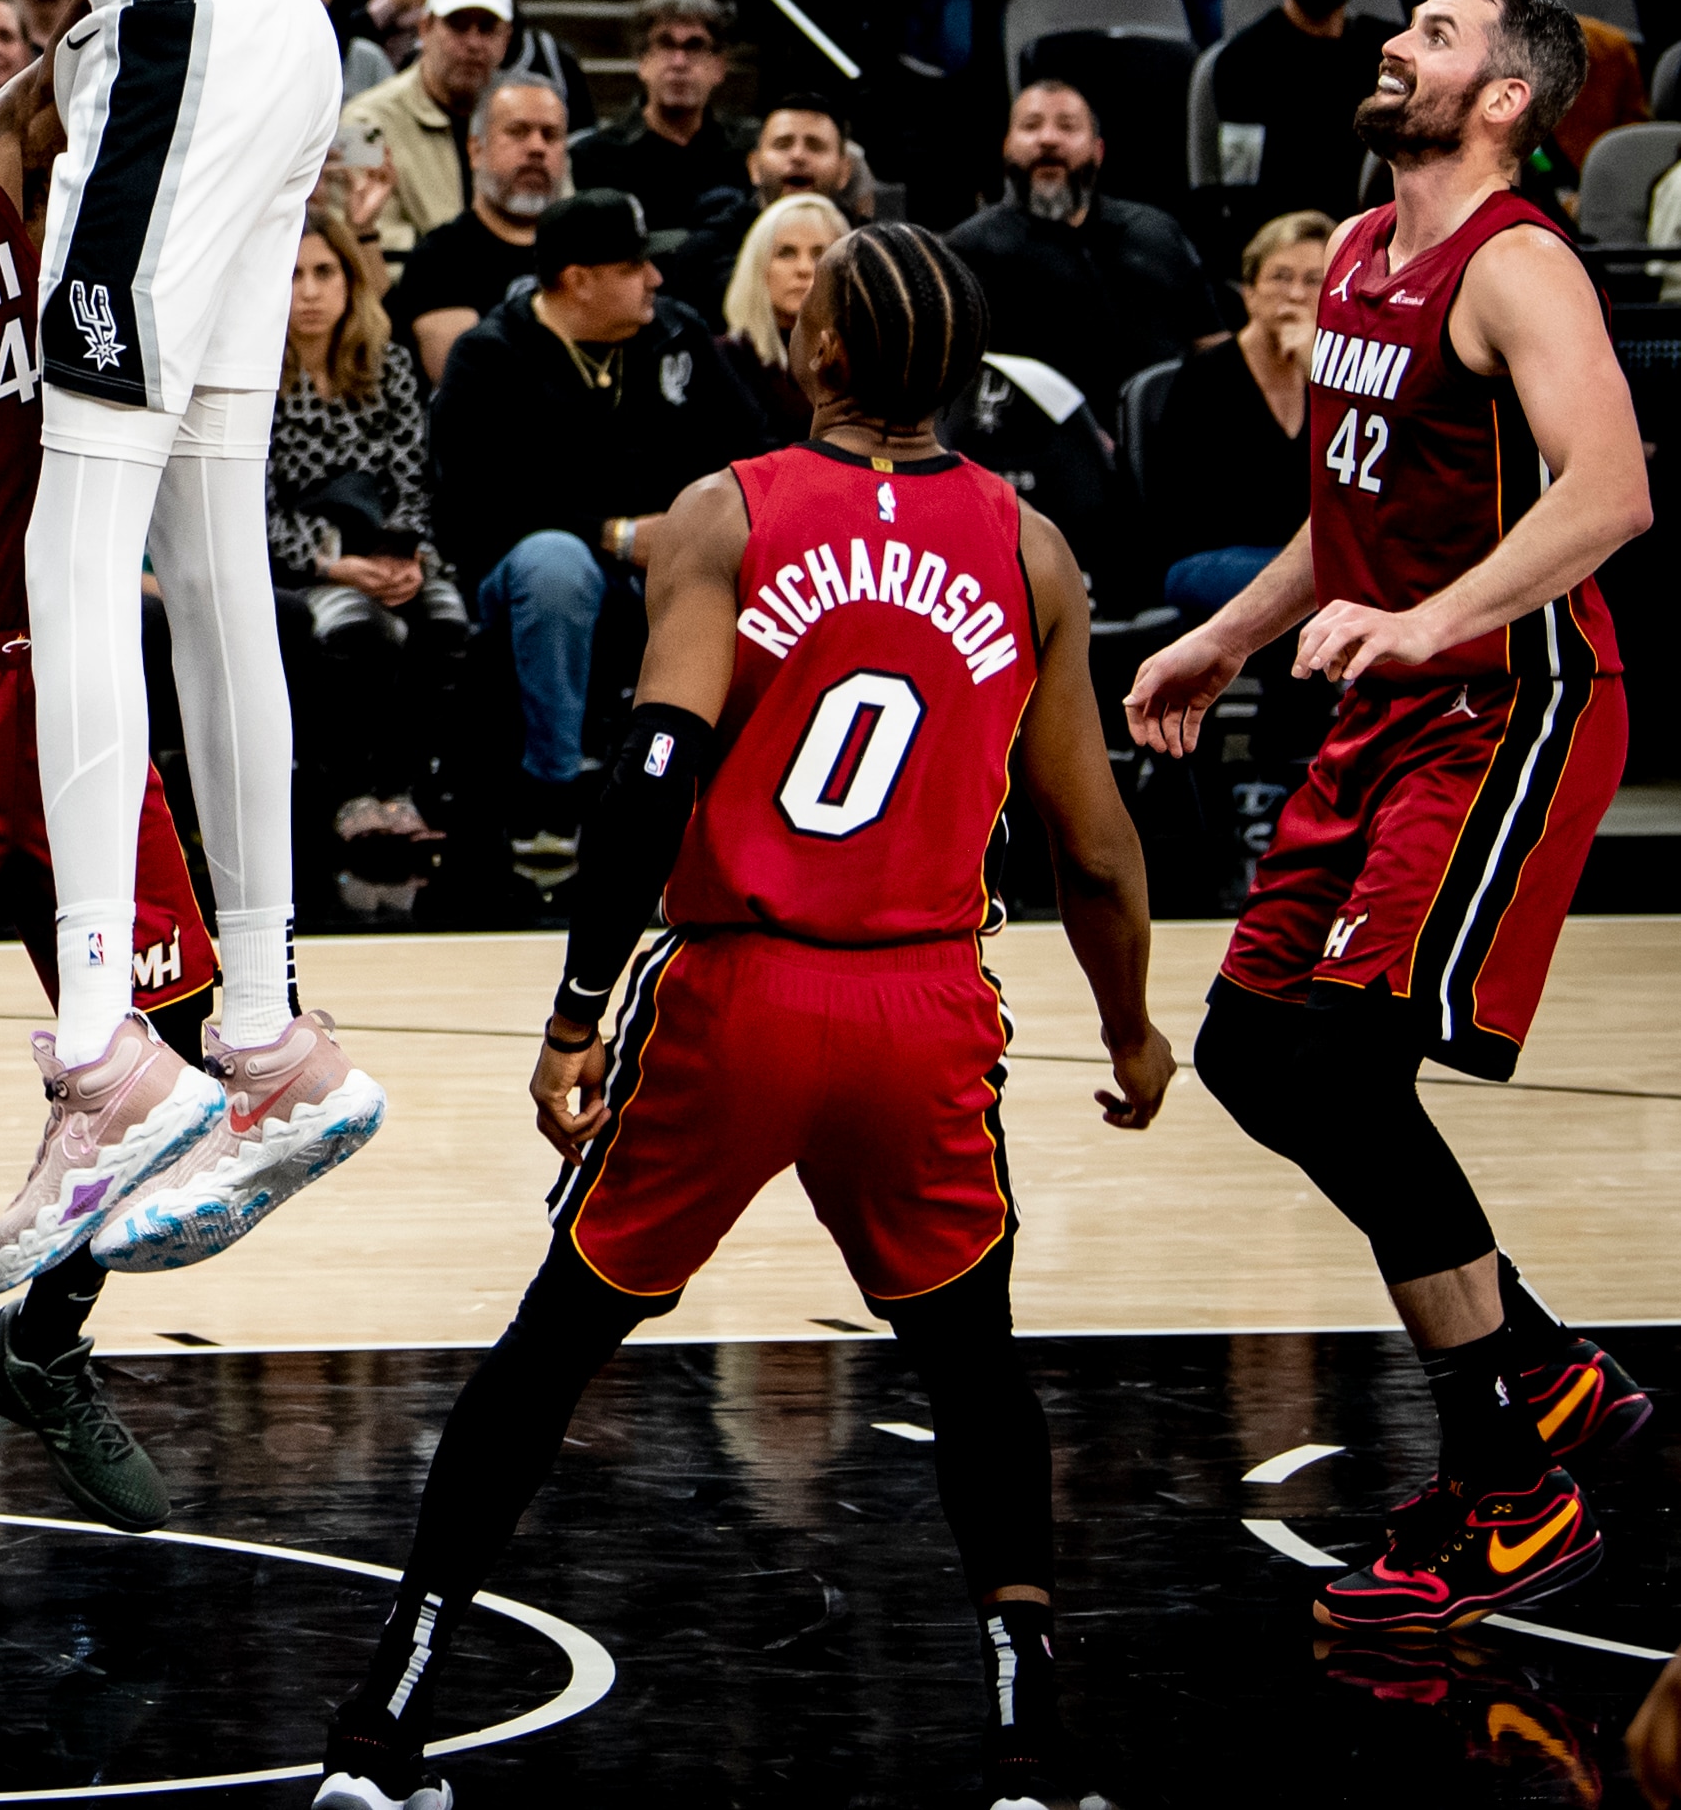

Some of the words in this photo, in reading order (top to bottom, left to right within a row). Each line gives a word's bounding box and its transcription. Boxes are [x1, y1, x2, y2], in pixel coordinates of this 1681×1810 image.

[1310, 328, 1412, 401] MIAMI
[1326, 407, 1389, 494] 42
[736, 537, 1018, 686] RICHARDSON
[772, 666, 930, 843] 0
